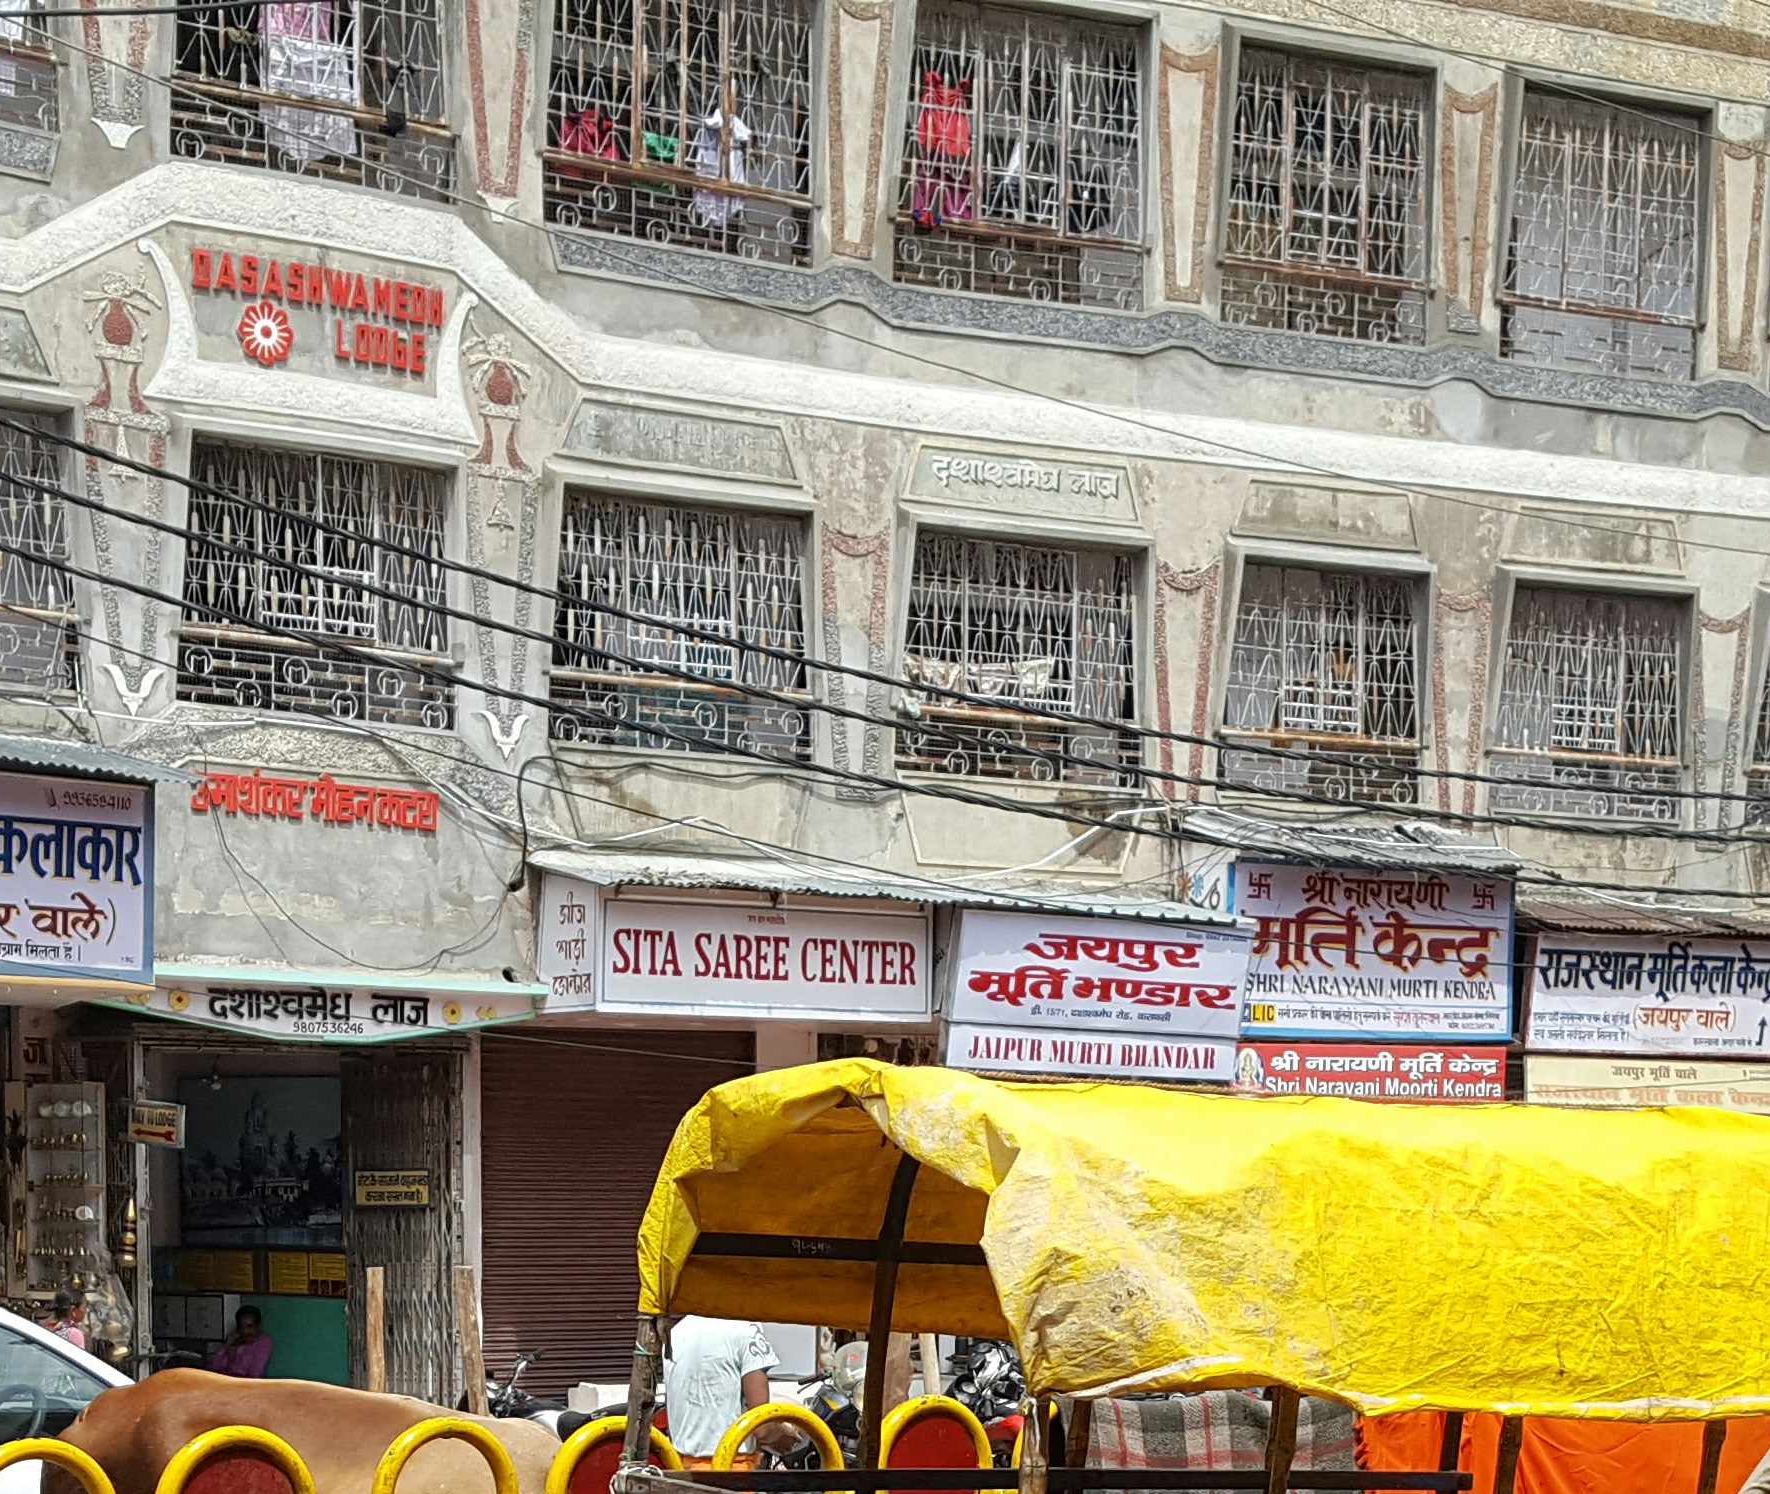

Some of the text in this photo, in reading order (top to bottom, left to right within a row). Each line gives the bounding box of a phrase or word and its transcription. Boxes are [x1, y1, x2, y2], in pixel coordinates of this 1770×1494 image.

[191, 247, 445, 327] DASASHWAMEDH
[335, 318, 426, 374] LODGE
[310, 773, 376, 825] मोहन
[1302, 870, 1451, 912] श्री नारायणी
[26, 892, 118, 945] वाले)
[612, 928, 918, 986] SITA SAREE CENTER
[1022, 931, 1204, 973] जयपुर
[1240, 905, 1500, 979] मूर्ति केन्द्र
[967, 965, 1237, 1011] मूर्ति भण्डार
[1246, 972, 1497, 1002] SHRI NARAYANI MURTI KENDRA
[1538, 948, 1647, 992] राजस्थान
[1647, 941, 1693, 1003] मूर्ति
[1690, 955, 1737, 995] कला
[206, 985, 430, 1027] दशाश्वमेध लाज
[1252, 1004, 1275, 1023] LIC
[292, 1021, 365, 1035] 9807536246
[968, 1035, 1217, 1071] JAIPUR MURTI BHANDAR
[1270, 1051, 1500, 1080] श्री नारायणी मूर्ति केन्द्र
[1265, 1075, 1301, 1093] Shri
[1385, 1077, 1438, 1097] Moorti
[1443, 1078, 1502, 1098] Kendra
